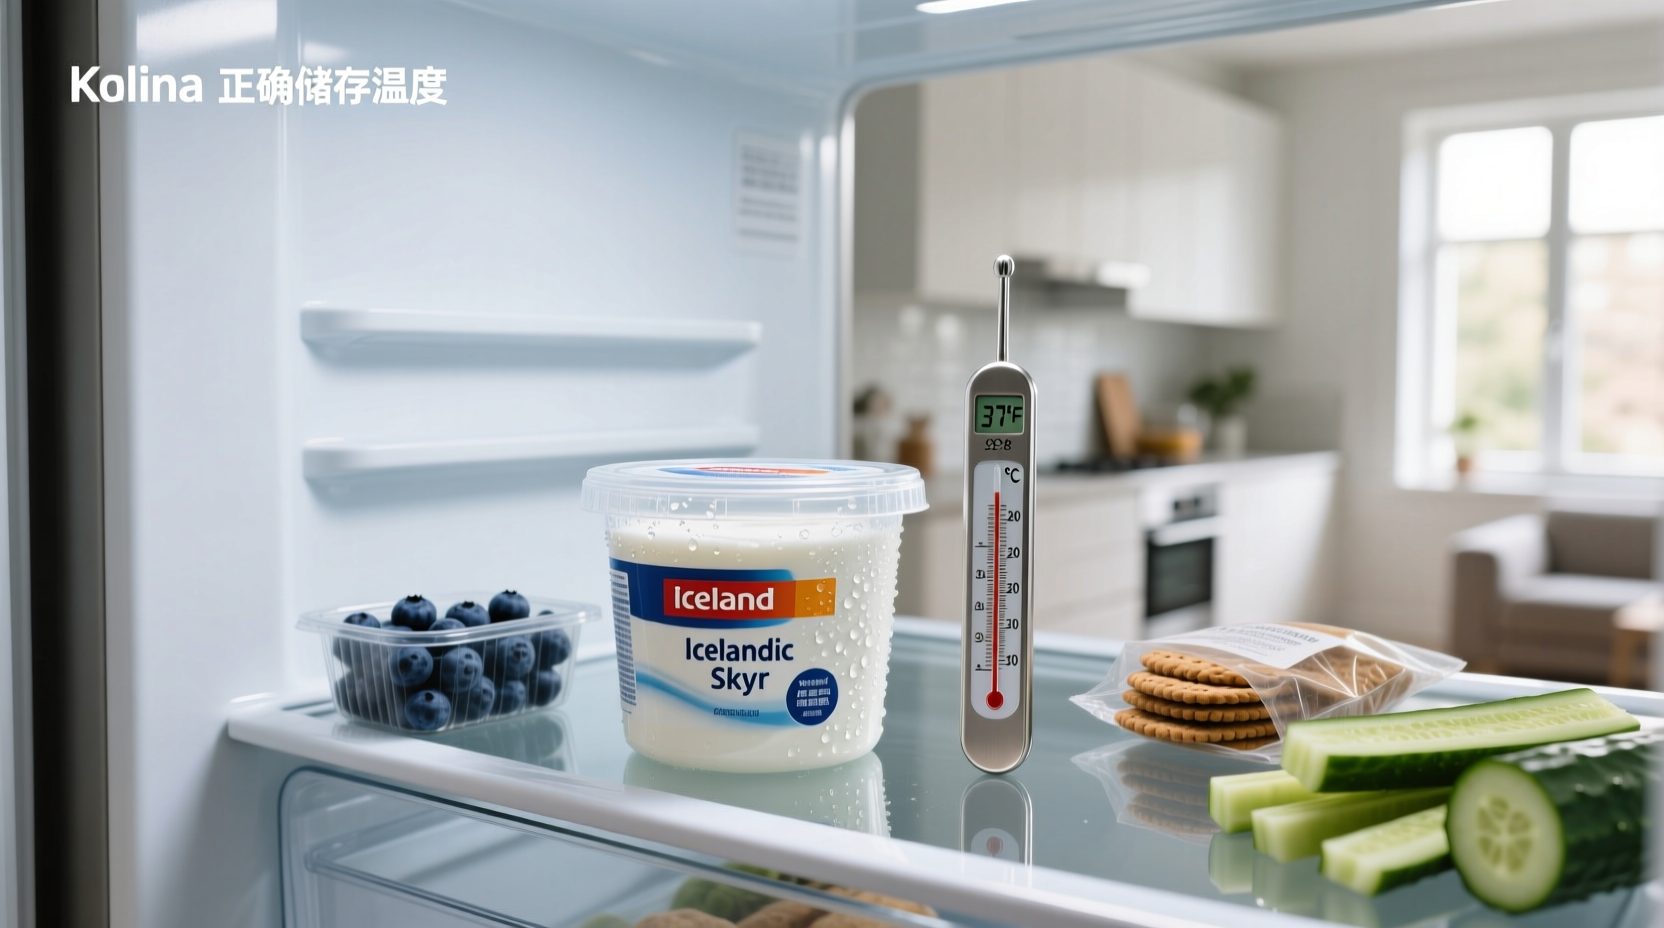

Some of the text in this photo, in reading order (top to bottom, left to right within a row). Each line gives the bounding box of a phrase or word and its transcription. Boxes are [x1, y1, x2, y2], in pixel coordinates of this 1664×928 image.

[674, 585, 775, 611] Iceland
[685, 637, 795, 662] Icelandic
[711, 666, 770, 697] Skyr
